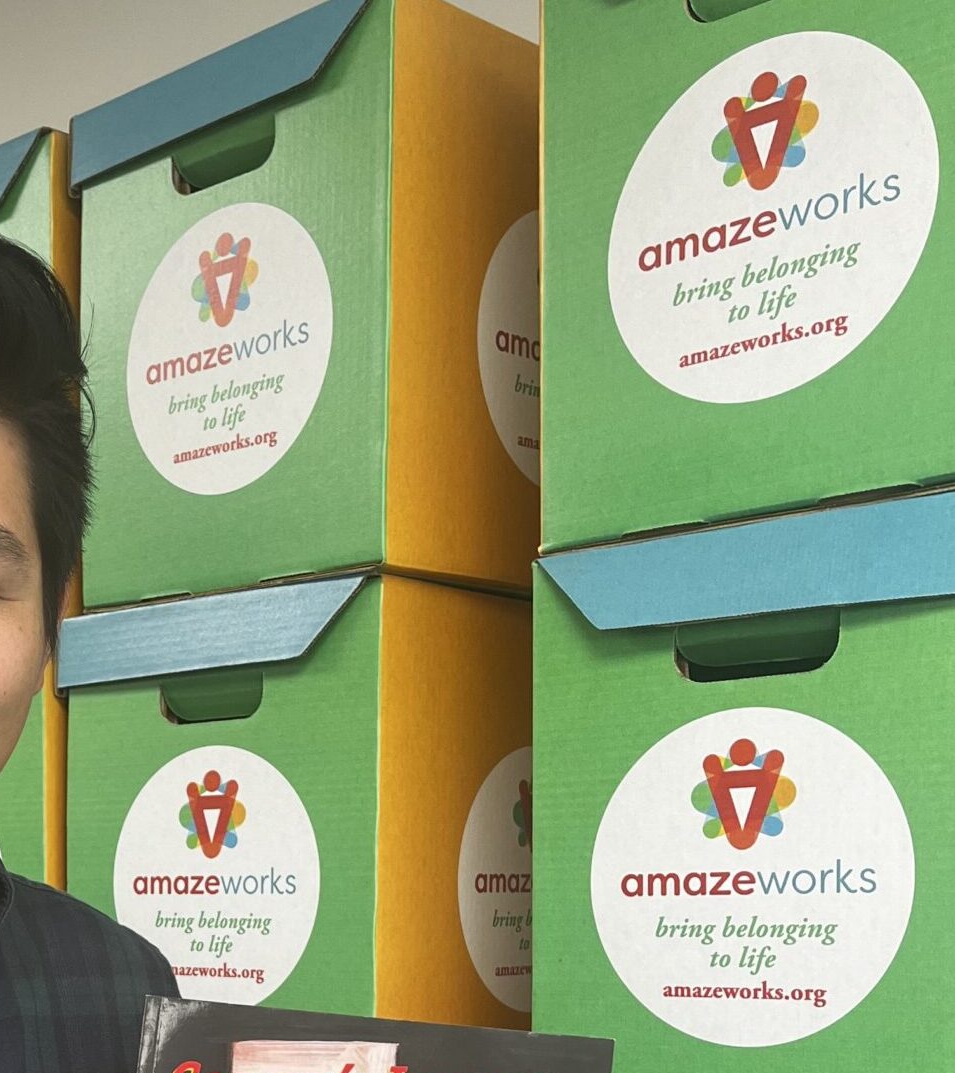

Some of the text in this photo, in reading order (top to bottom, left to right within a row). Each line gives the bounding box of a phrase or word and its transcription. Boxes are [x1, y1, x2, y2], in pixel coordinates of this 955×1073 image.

[638, 173, 901, 271] amazeworks
[673, 241, 861, 306] bring belonging
[728, 285, 797, 323] to life
[146, 320, 309, 385] amazeworks
[679, 315, 848, 368] amazeworks.org
[168, 373, 285, 415] bring belonging
[514, 374, 540, 393] brin
[204, 404, 246, 431] to life
[173, 431, 277, 464] amazeworks.org
[133, 867, 296, 895] amazeworks
[621, 859, 877, 898] amazeworks
[155, 910, 272, 934] bring belonging
[492, 909, 523, 932] bring
[655, 916, 838, 945] bring belonging
[190, 935, 233, 958] to life
[709, 946, 777, 975] to life
[171, 963, 264, 983] mazeworks.org
[662, 981, 828, 1007] amazeworks.org
